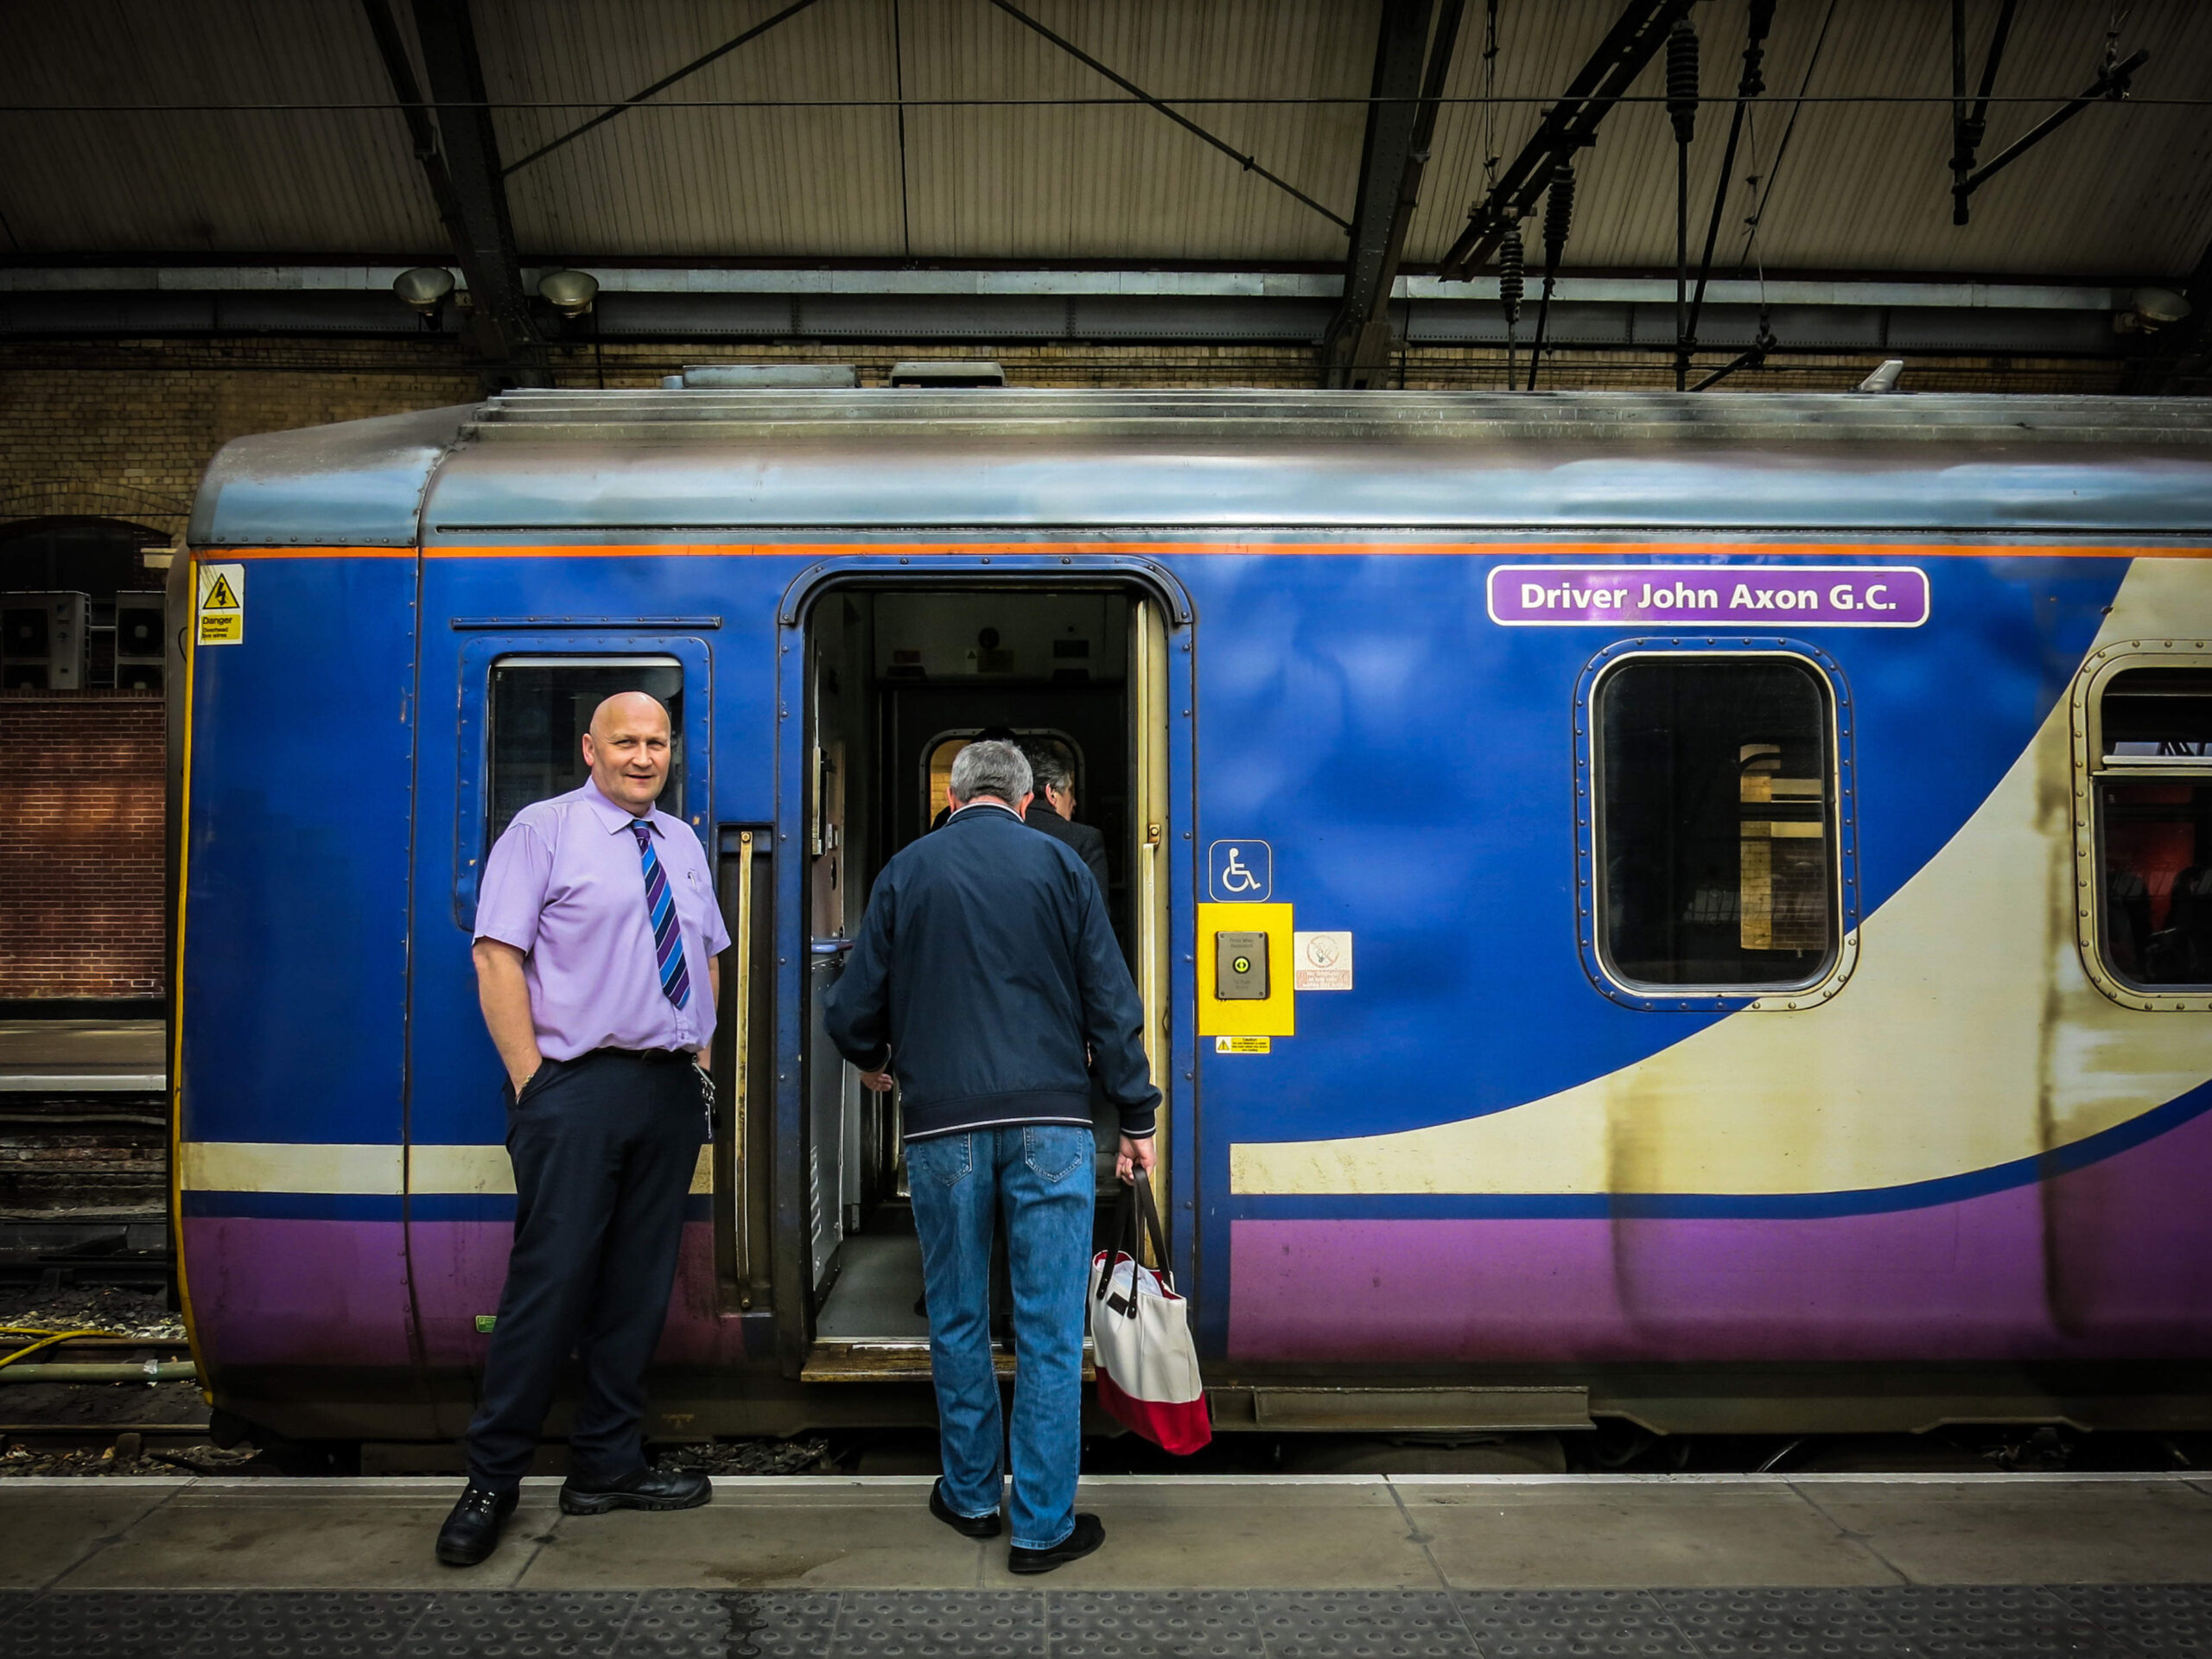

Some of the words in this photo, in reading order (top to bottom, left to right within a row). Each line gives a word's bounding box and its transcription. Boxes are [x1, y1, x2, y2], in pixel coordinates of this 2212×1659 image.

[1521, 582, 1628, 609] Driver
[1637, 583, 1719, 610] John
[1729, 583, 1818, 610] Axon
[1828, 584, 1897, 610] G.C.
